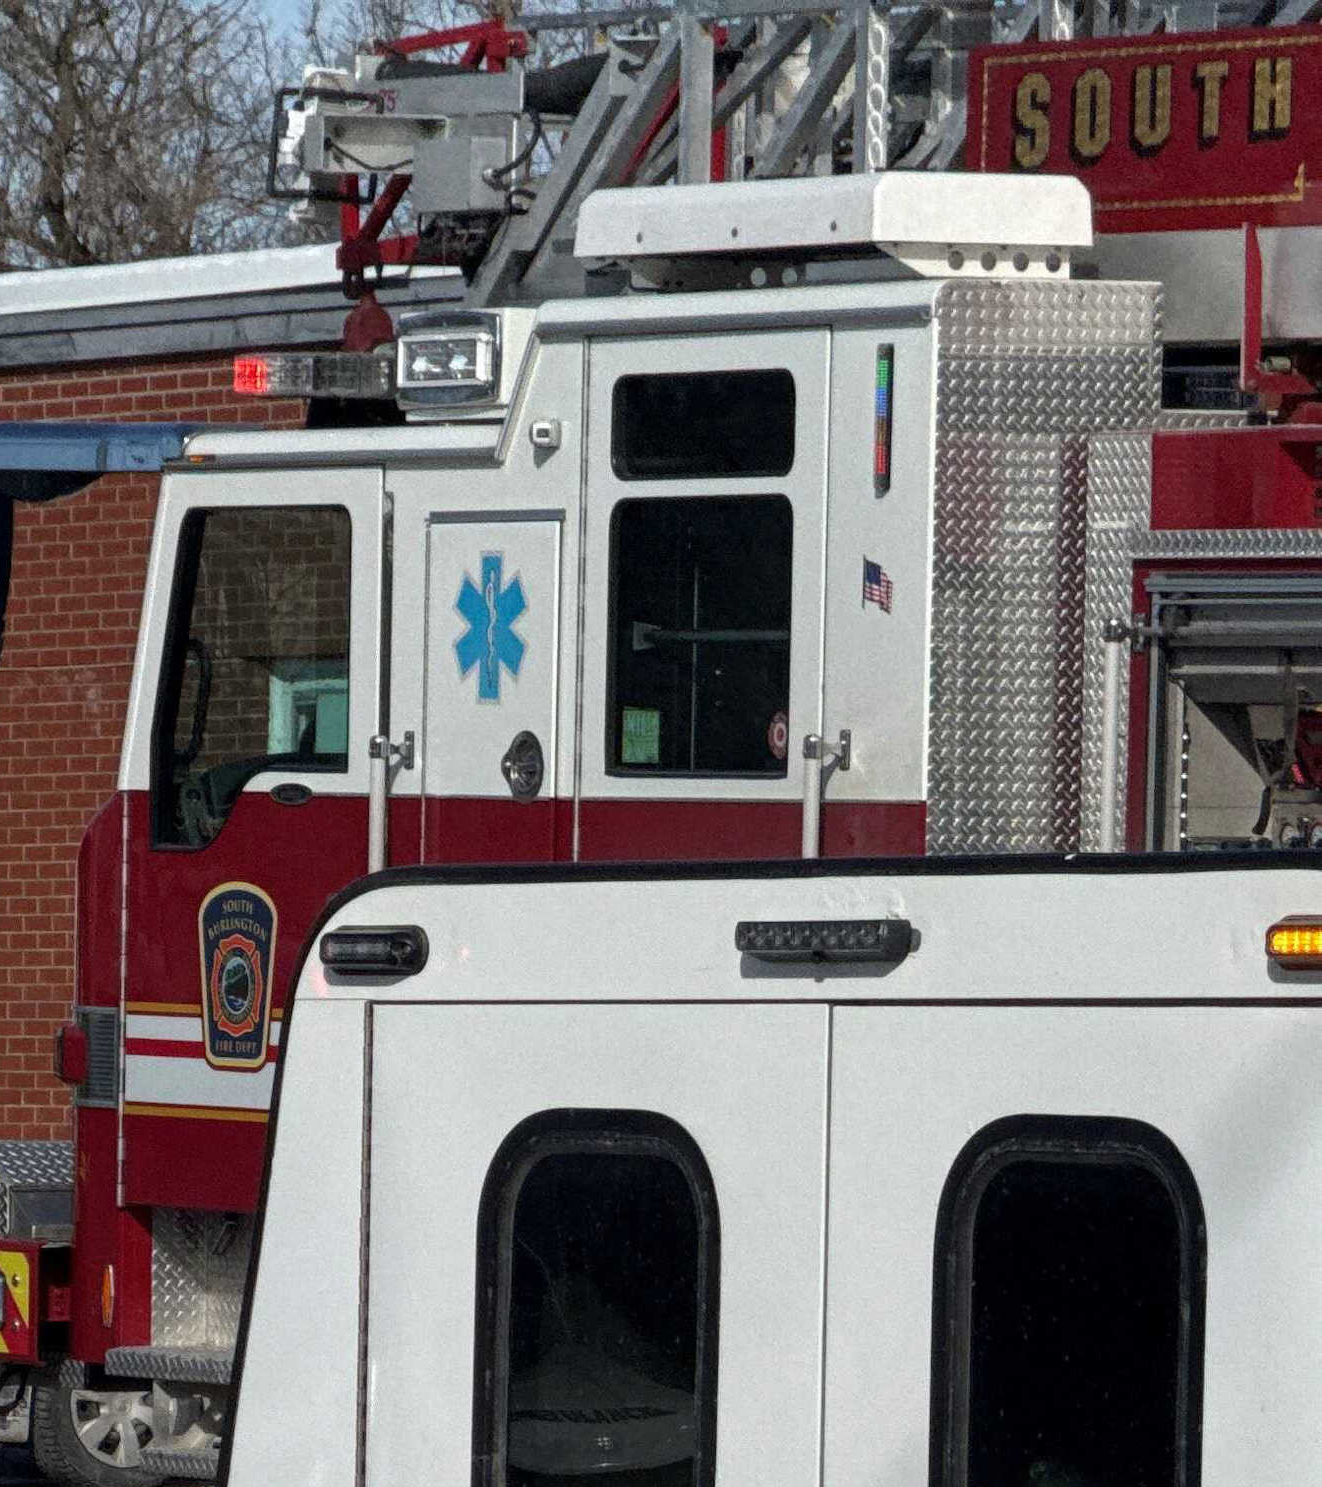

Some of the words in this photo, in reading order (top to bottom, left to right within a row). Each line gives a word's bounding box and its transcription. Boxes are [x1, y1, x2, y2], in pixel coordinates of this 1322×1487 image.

[1013, 56, 1293, 170] SOUTH
[220, 899, 254, 915] SOUTH
[207, 917, 267, 941] BURLINGTON
